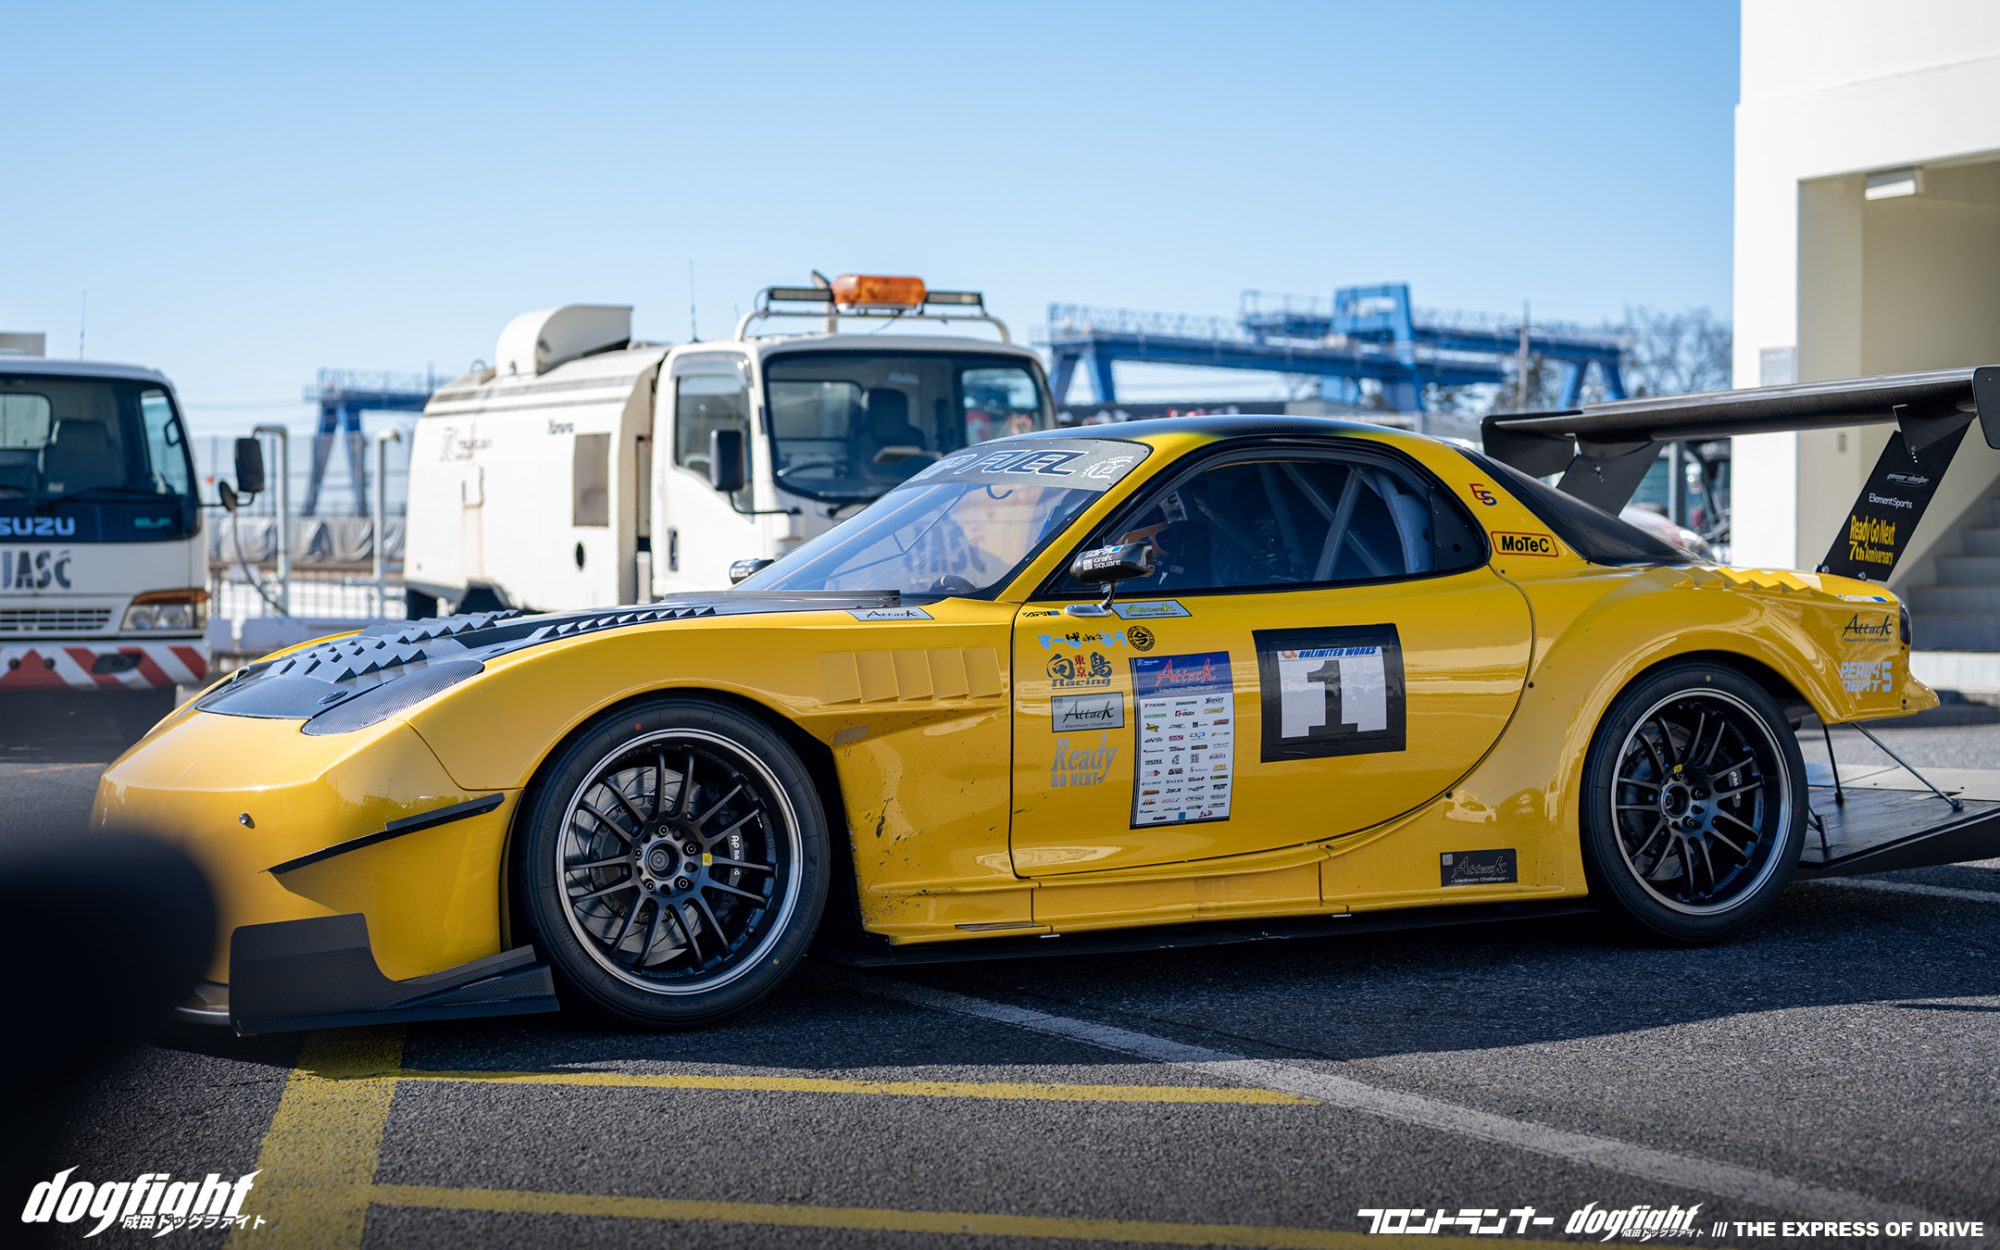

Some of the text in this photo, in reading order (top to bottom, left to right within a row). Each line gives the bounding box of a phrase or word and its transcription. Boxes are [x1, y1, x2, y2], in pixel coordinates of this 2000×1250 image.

[1868, 492, 1912, 509] ElementSports
[1850, 515, 1895, 548] Ready Go Next
[1501, 535, 1549, 553] MoTeC
[1094, 554, 1112, 562] craft
[1849, 541, 1894, 566] 7th Anniversary
[1094, 560, 1121, 569] square
[1842, 613, 1893, 637] Attack
[1299, 648, 1344, 659] UNLIMITED
[1346, 646, 1377, 656] WORKS
[1153, 658, 1217, 687] Attack
[1052, 678, 1112, 687] Racing
[1307, 660, 1359, 736] 1
[1063, 700, 1115, 723] Attack
[1050, 732, 1119, 784] Ready
[1050, 771, 1099, 788] GO NEXT
[731, 835, 740, 849] AP
